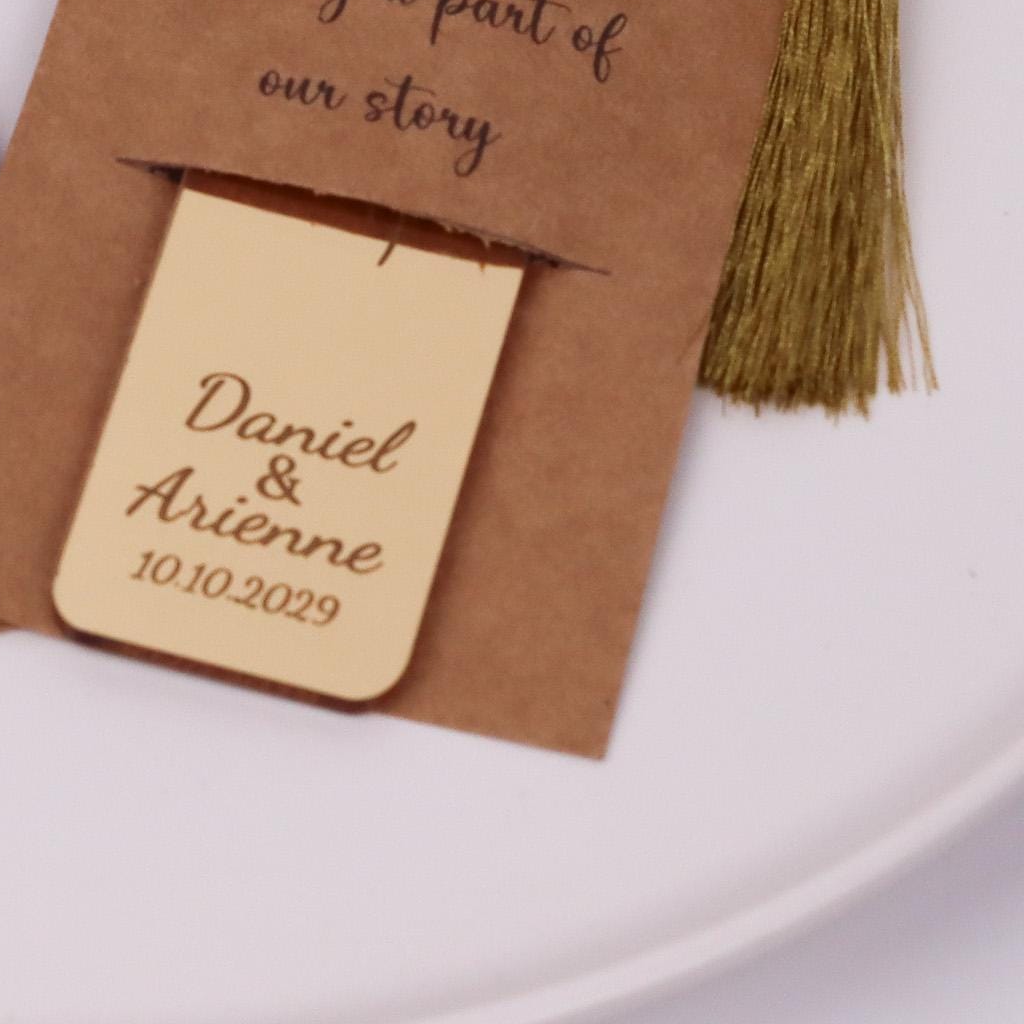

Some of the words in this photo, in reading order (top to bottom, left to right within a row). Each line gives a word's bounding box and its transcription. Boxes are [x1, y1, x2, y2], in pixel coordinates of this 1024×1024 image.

[571, 12, 628, 83] of
[258, 67, 347, 111] our
[363, 74, 503, 176] story
[185, 372, 417, 473] Daniel
[126, 466, 384, 575] Arienne
[256, 454, 301, 506] &
[131, 550, 341, 627] 10.10.2029
